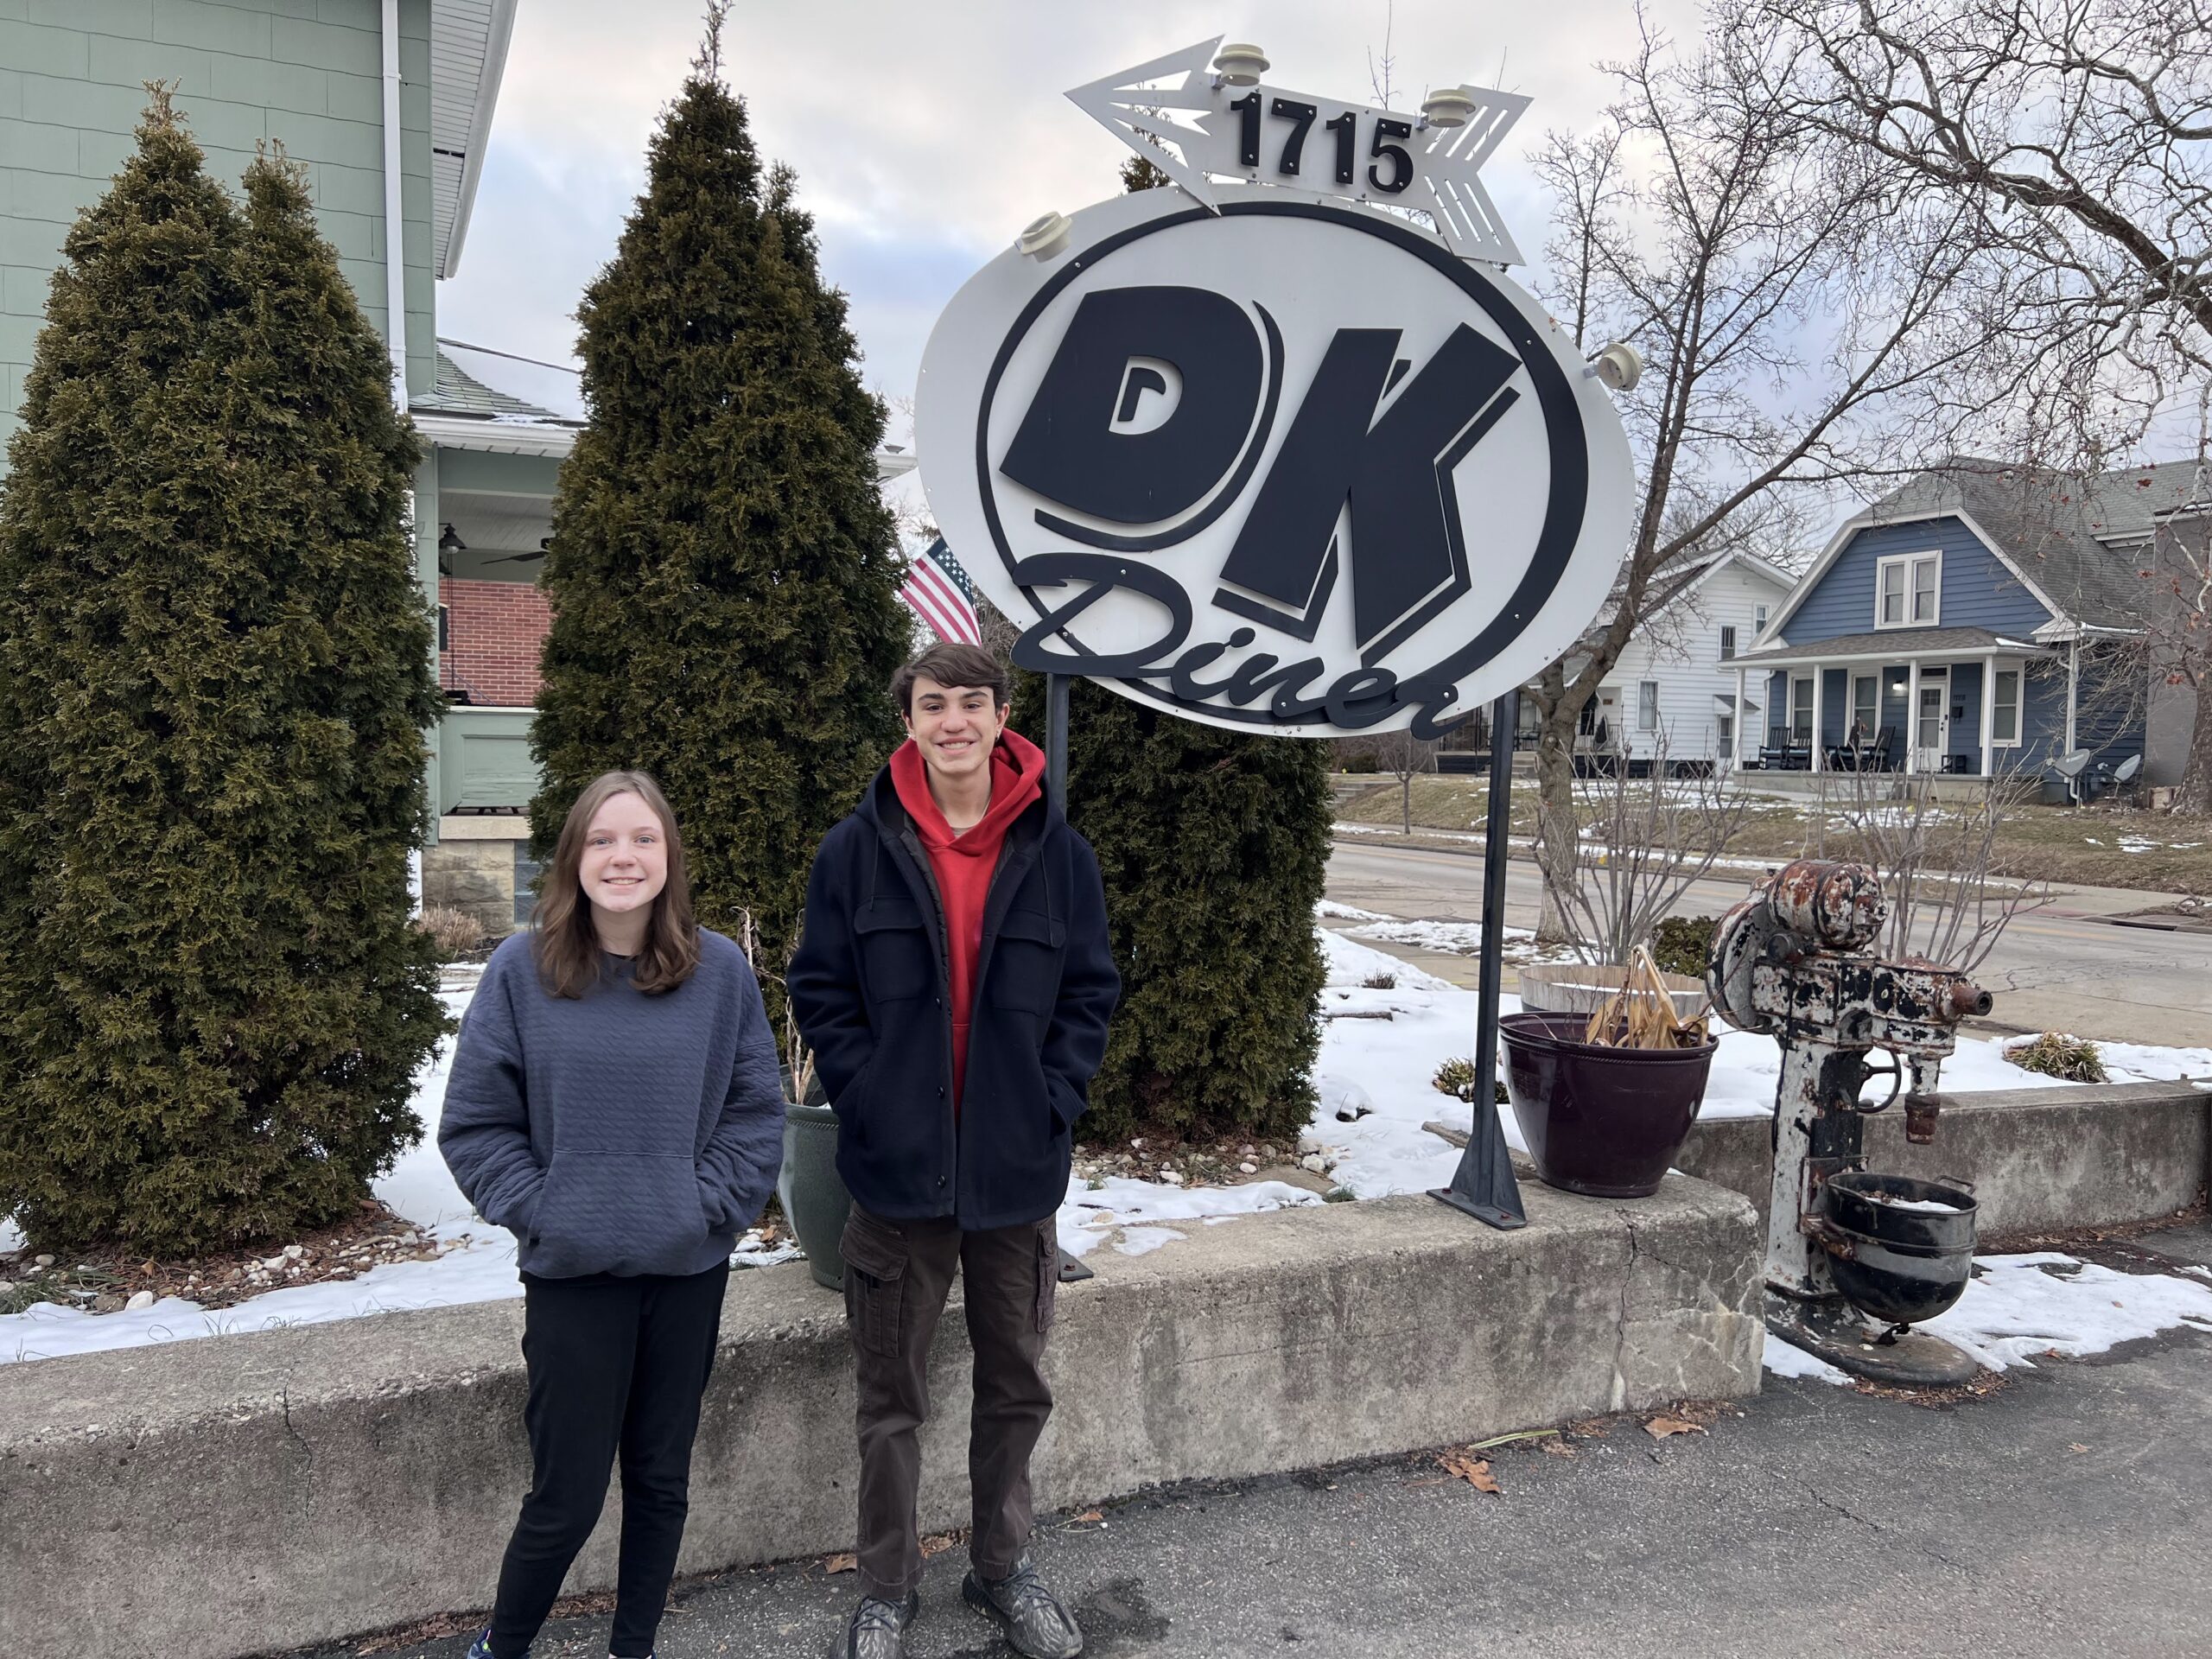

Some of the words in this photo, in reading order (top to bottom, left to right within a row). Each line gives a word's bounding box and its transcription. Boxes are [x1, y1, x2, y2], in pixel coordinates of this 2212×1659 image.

[1230, 92, 1414, 194] 1715
[1000, 286, 1522, 657] DK
[1010, 553, 1467, 741] Diner
